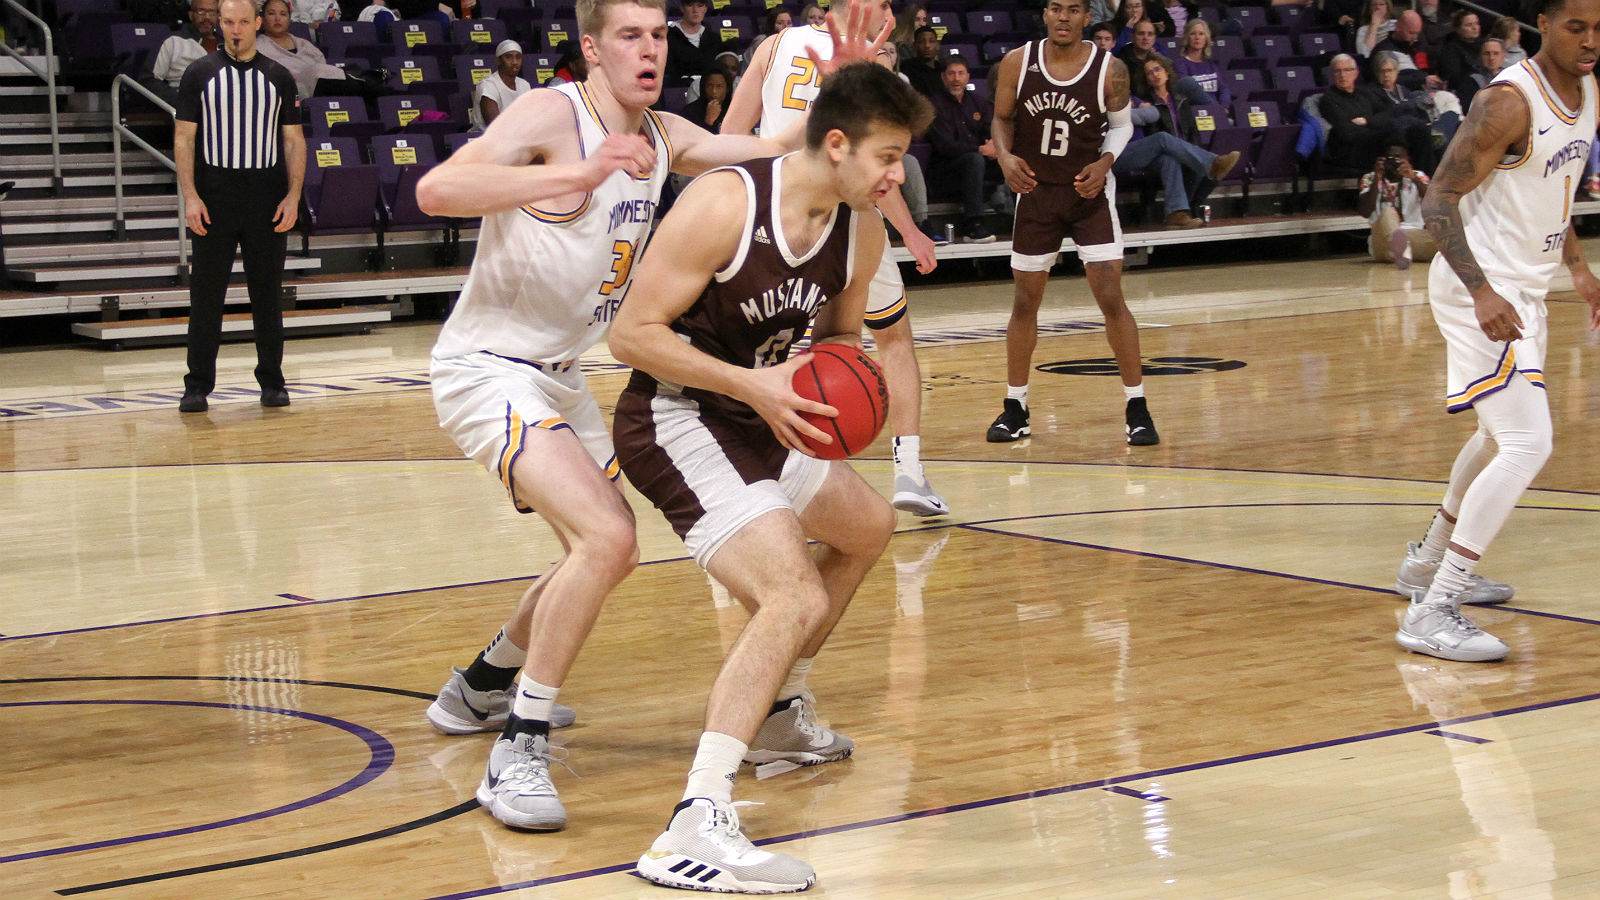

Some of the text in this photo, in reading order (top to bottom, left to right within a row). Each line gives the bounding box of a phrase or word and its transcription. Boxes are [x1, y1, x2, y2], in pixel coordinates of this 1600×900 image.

[1024, 91, 1091, 125] MUSTANGS
[1040, 118, 1069, 157] 13
[1562, 175, 1570, 223] 1
